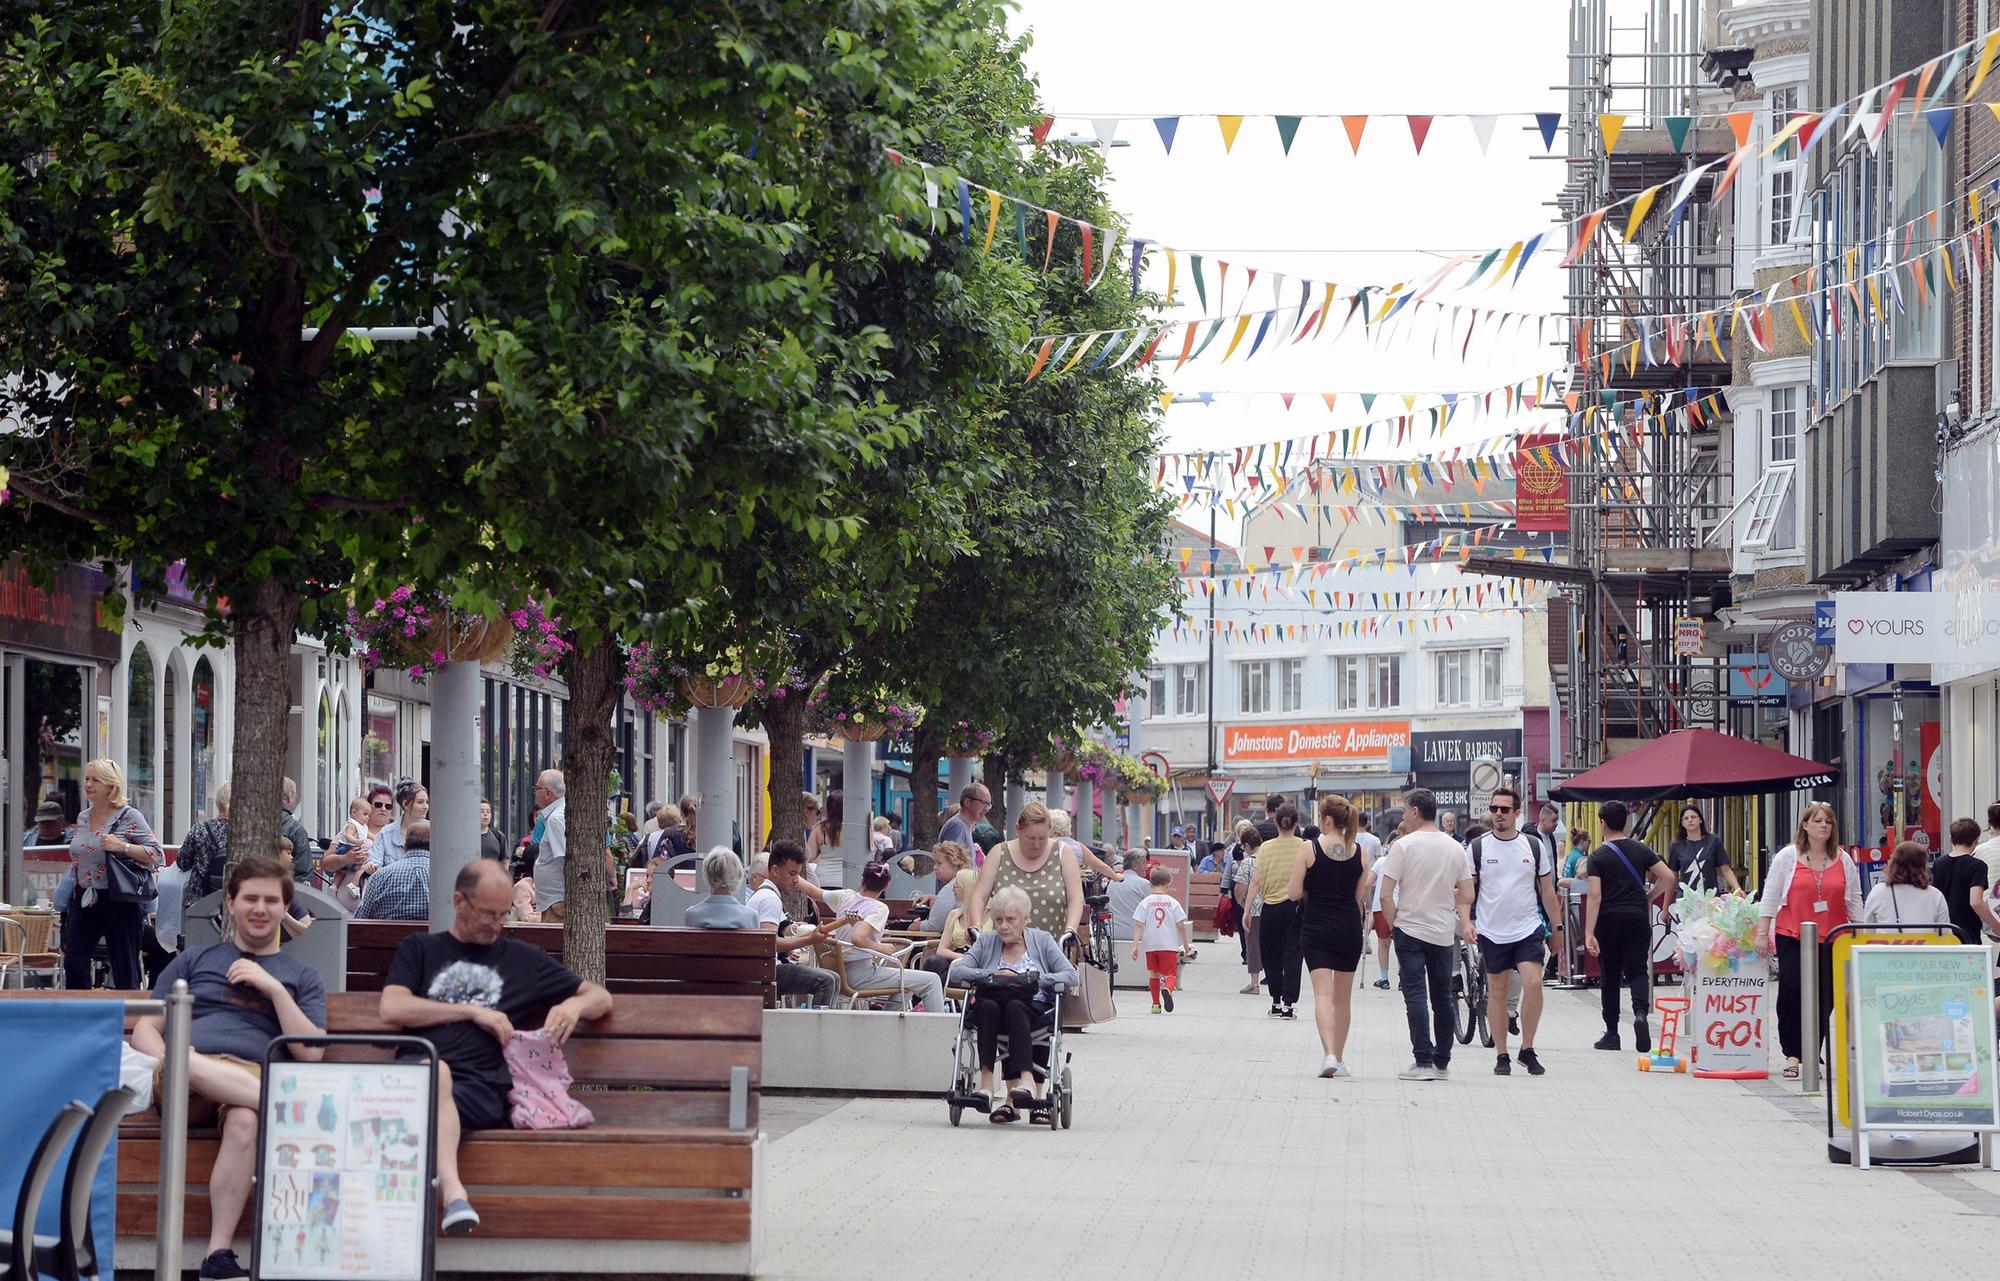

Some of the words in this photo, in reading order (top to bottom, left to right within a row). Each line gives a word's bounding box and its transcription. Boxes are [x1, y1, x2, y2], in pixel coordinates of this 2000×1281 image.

[1520, 483, 1563, 496] SCAFFOLDING
[1678, 629, 1699, 637] NRG
[1780, 627, 1816, 643] COSTA
[1866, 619, 1925, 636] YOURS
[1777, 656, 1823, 676] COFFEE
[1228, 731, 1283, 756] Johnstons
[1287, 729, 1341, 754] Domestic
[1344, 727, 1406, 753] Appliances
[1424, 740, 1462, 762] LAWEK
[1465, 741, 1503, 761] BARBERS
[1794, 775, 1832, 788] COSTA
[1155, 907, 1166, 928] 9
[1907, 960, 1918, 969] UP
[1919, 960, 1937, 969] OUR
[1939, 960, 1961, 969] NEW
[1702, 977, 1765, 988] EVERYTHING
[1954, 972, 1982, 982] TODAY
[1705, 994, 1762, 1015] MUST
[1705, 1018, 1762, 1050] GO!
